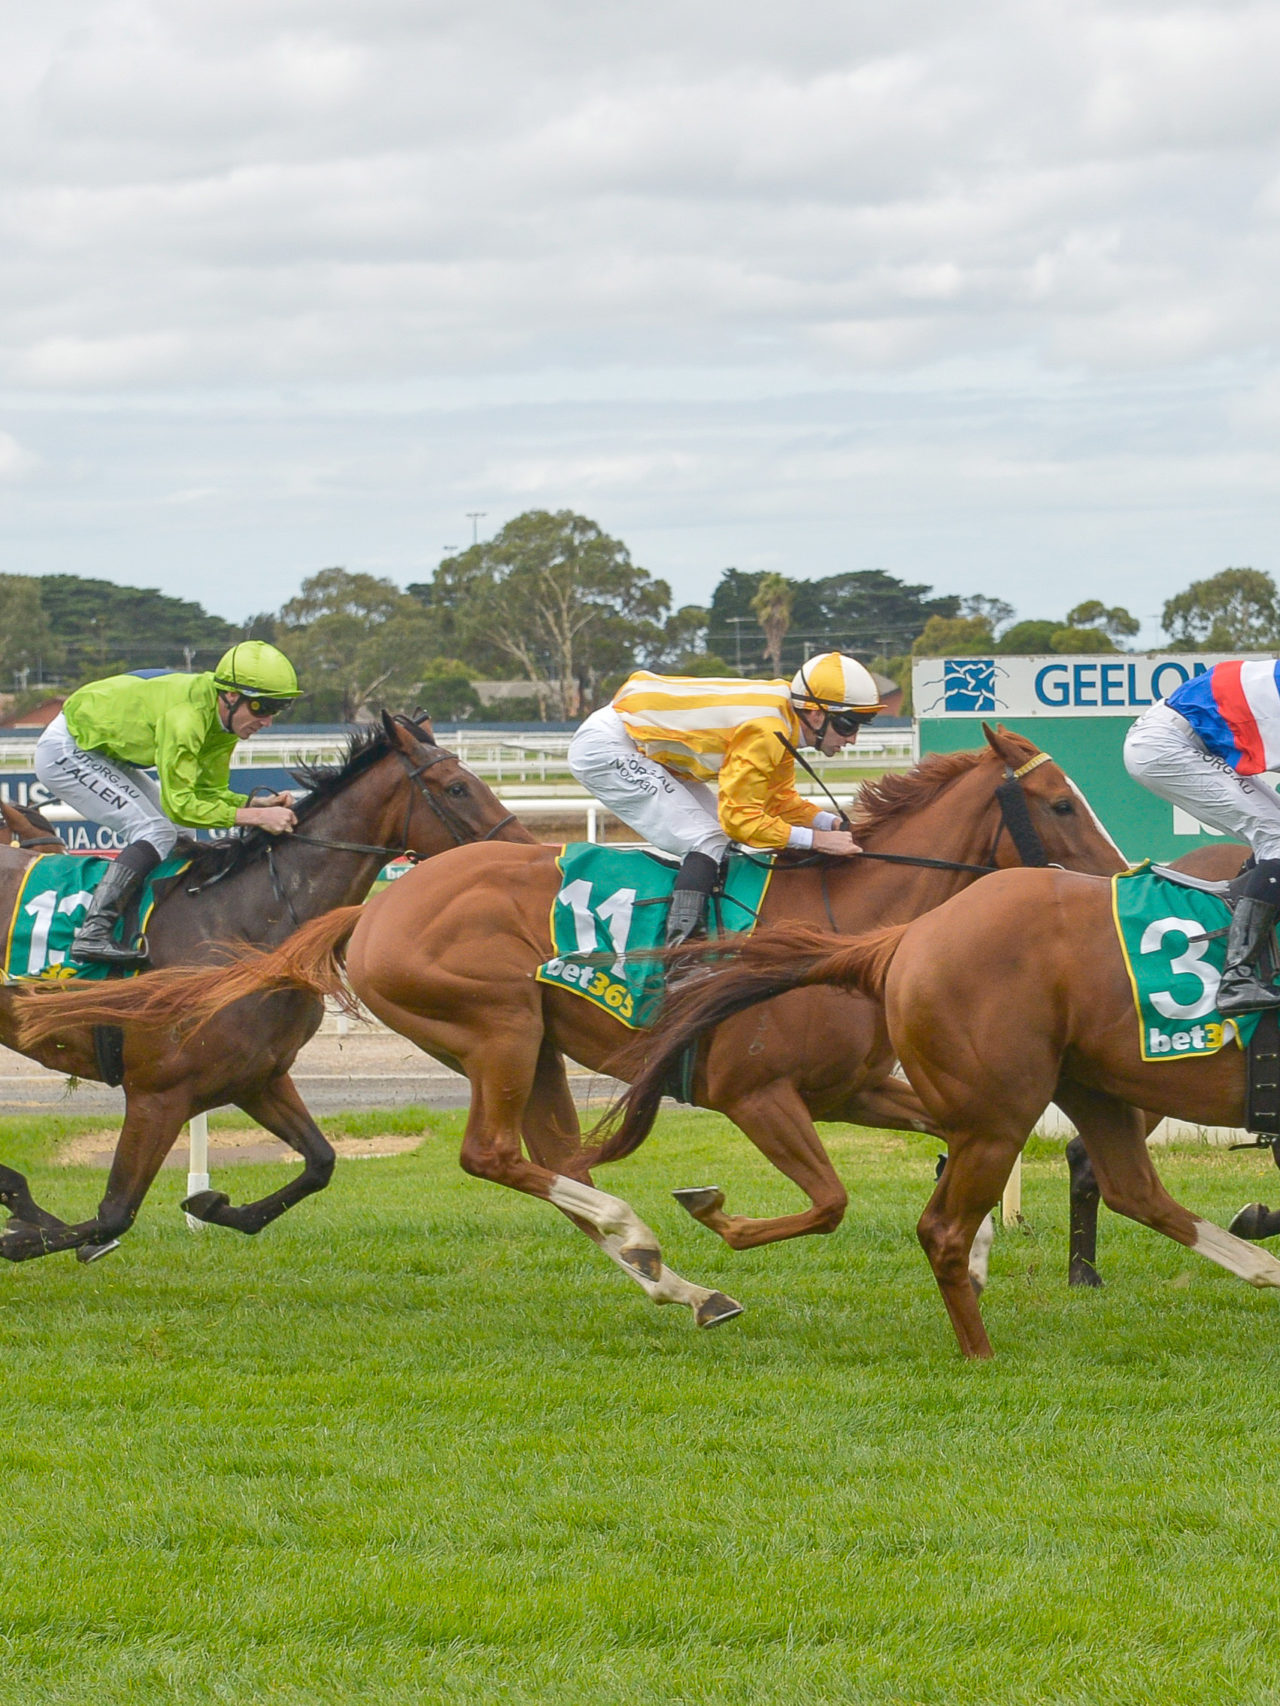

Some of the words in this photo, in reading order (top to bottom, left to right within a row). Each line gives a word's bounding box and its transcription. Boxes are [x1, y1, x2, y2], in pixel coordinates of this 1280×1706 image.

[1035, 662, 1208, 707] GEELO
[558, 879, 636, 980] 11
[1140, 917, 1221, 1019] 3
[546, 957, 634, 1018] bet365
